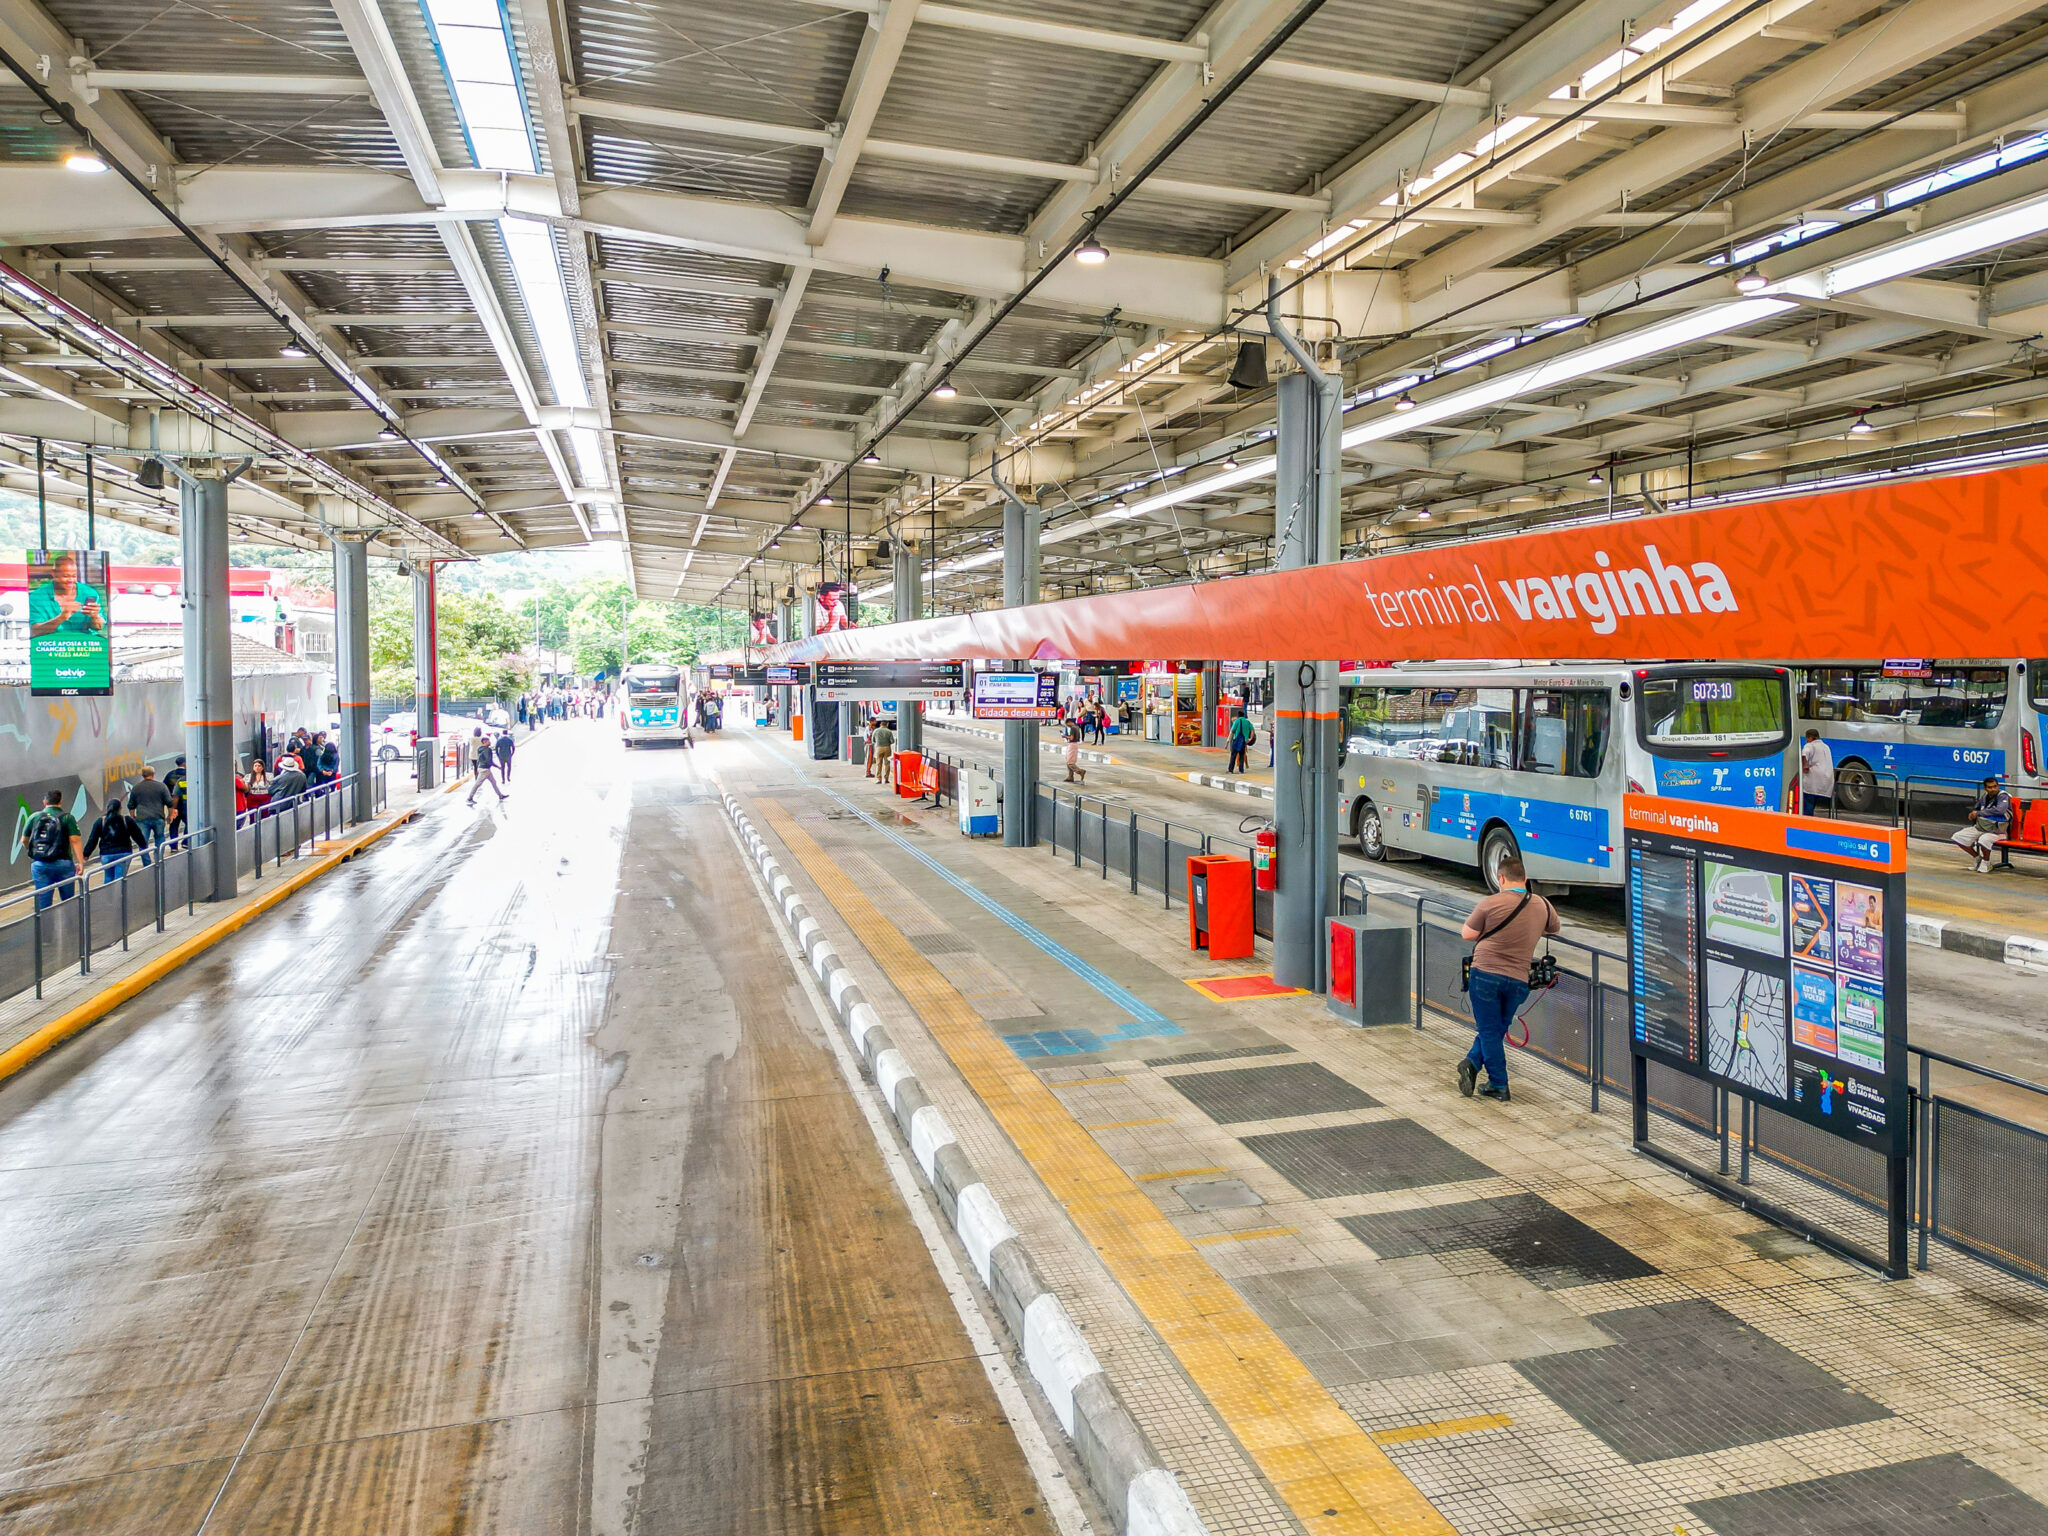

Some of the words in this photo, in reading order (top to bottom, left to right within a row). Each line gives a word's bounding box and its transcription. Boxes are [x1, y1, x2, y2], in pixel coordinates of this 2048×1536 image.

[1364, 563, 1500, 629] terminal
[1498, 544, 1739, 635] varginha
[55, 668, 86, 678] betvip
[1693, 682, 1732, 700] 6073-10
[979, 708, 1009, 717] Cidade
[1010, 708, 1038, 717] deseja
[1953, 749, 1960, 762] 6
[1963, 750, 1990, 764] 6057
[104, 745, 142, 793] juntos
[1744, 768, 1751, 778] 6
[1753, 767, 1776, 777] 6761
[1659, 779, 1702, 787] TRANSWOLFF
[1569, 808, 1574, 819] 6
[1575, 809, 1592, 822] 6761
[1629, 805, 1667, 824] terminal
[1668, 814, 1719, 833] varginha
[1857, 843, 1868, 851] sul
[1870, 844, 1879, 858] 6
[1802, 984, 1817, 994] ESTÁ
[1847, 1104, 1886, 1124] VIVACIDADE
